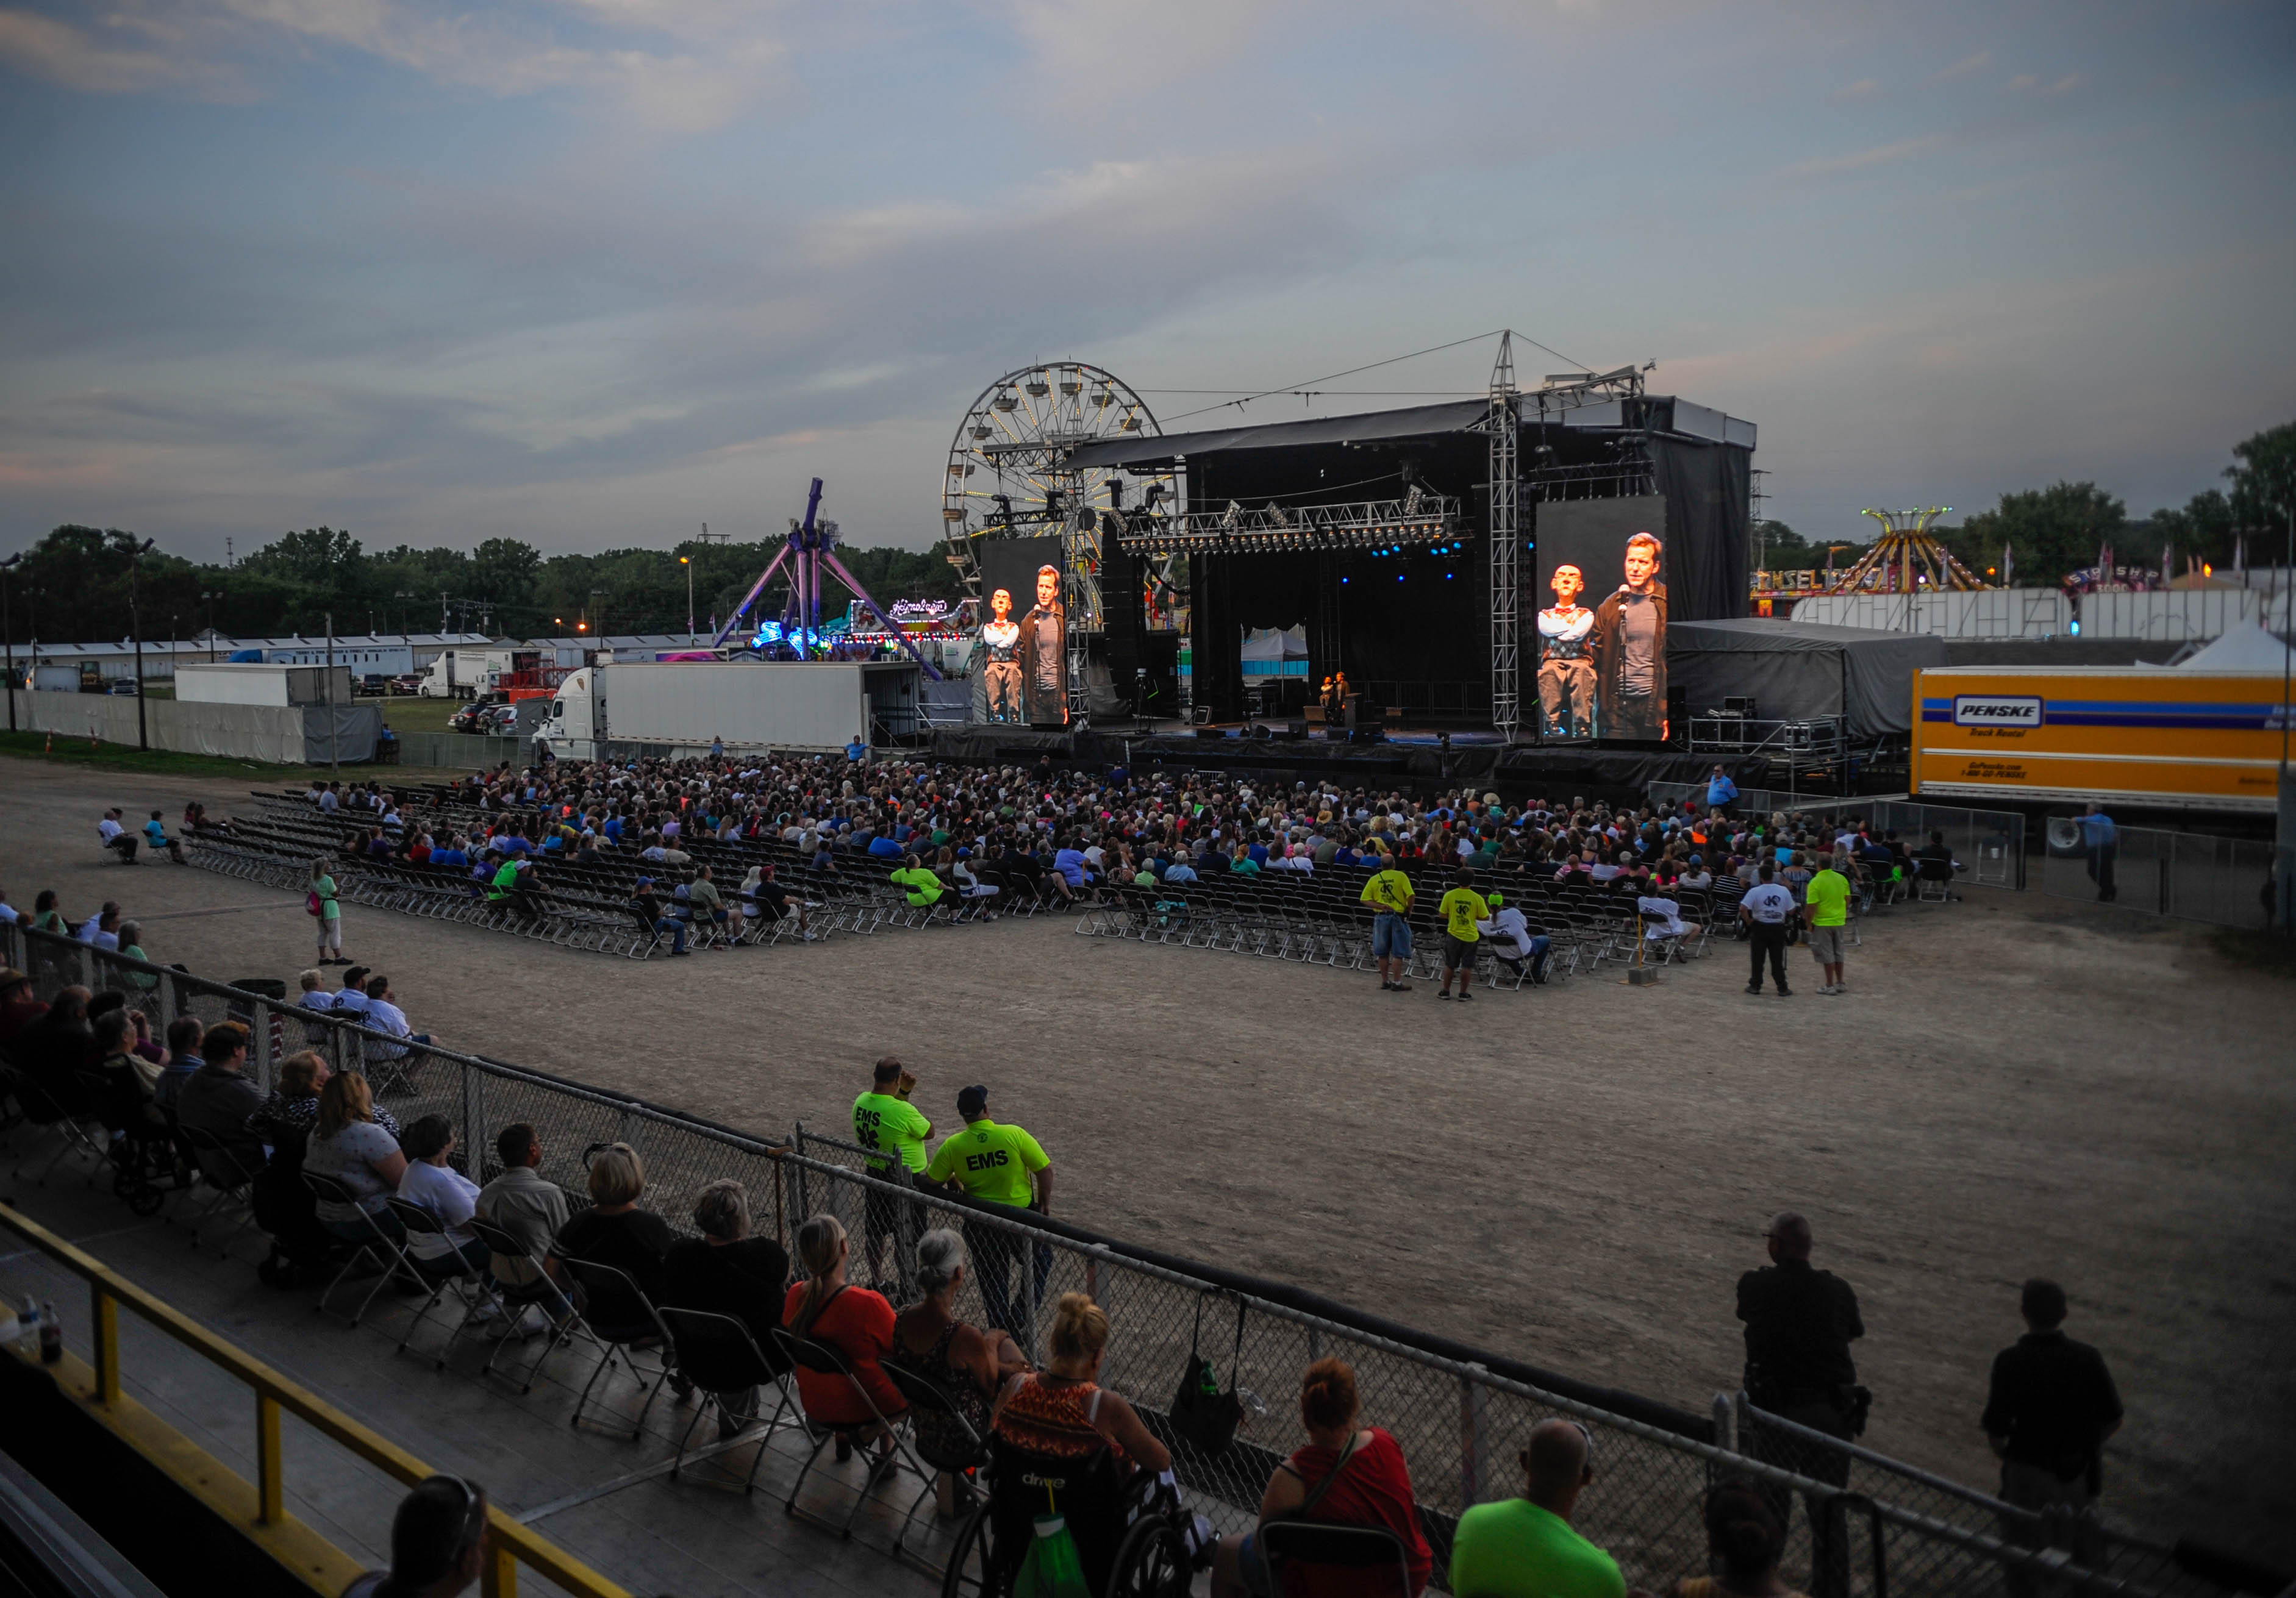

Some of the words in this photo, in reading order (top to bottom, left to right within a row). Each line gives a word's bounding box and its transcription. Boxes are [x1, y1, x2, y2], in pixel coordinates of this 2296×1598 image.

[1961, 705, 2036, 717] PENSKE
[1970, 728, 1994, 737] Truck
[1995, 729, 2026, 737] Rental
[856, 1107, 881, 1127] EMS
[966, 1149, 1009, 1171] EMS
[1021, 1471, 1065, 1488] drive
